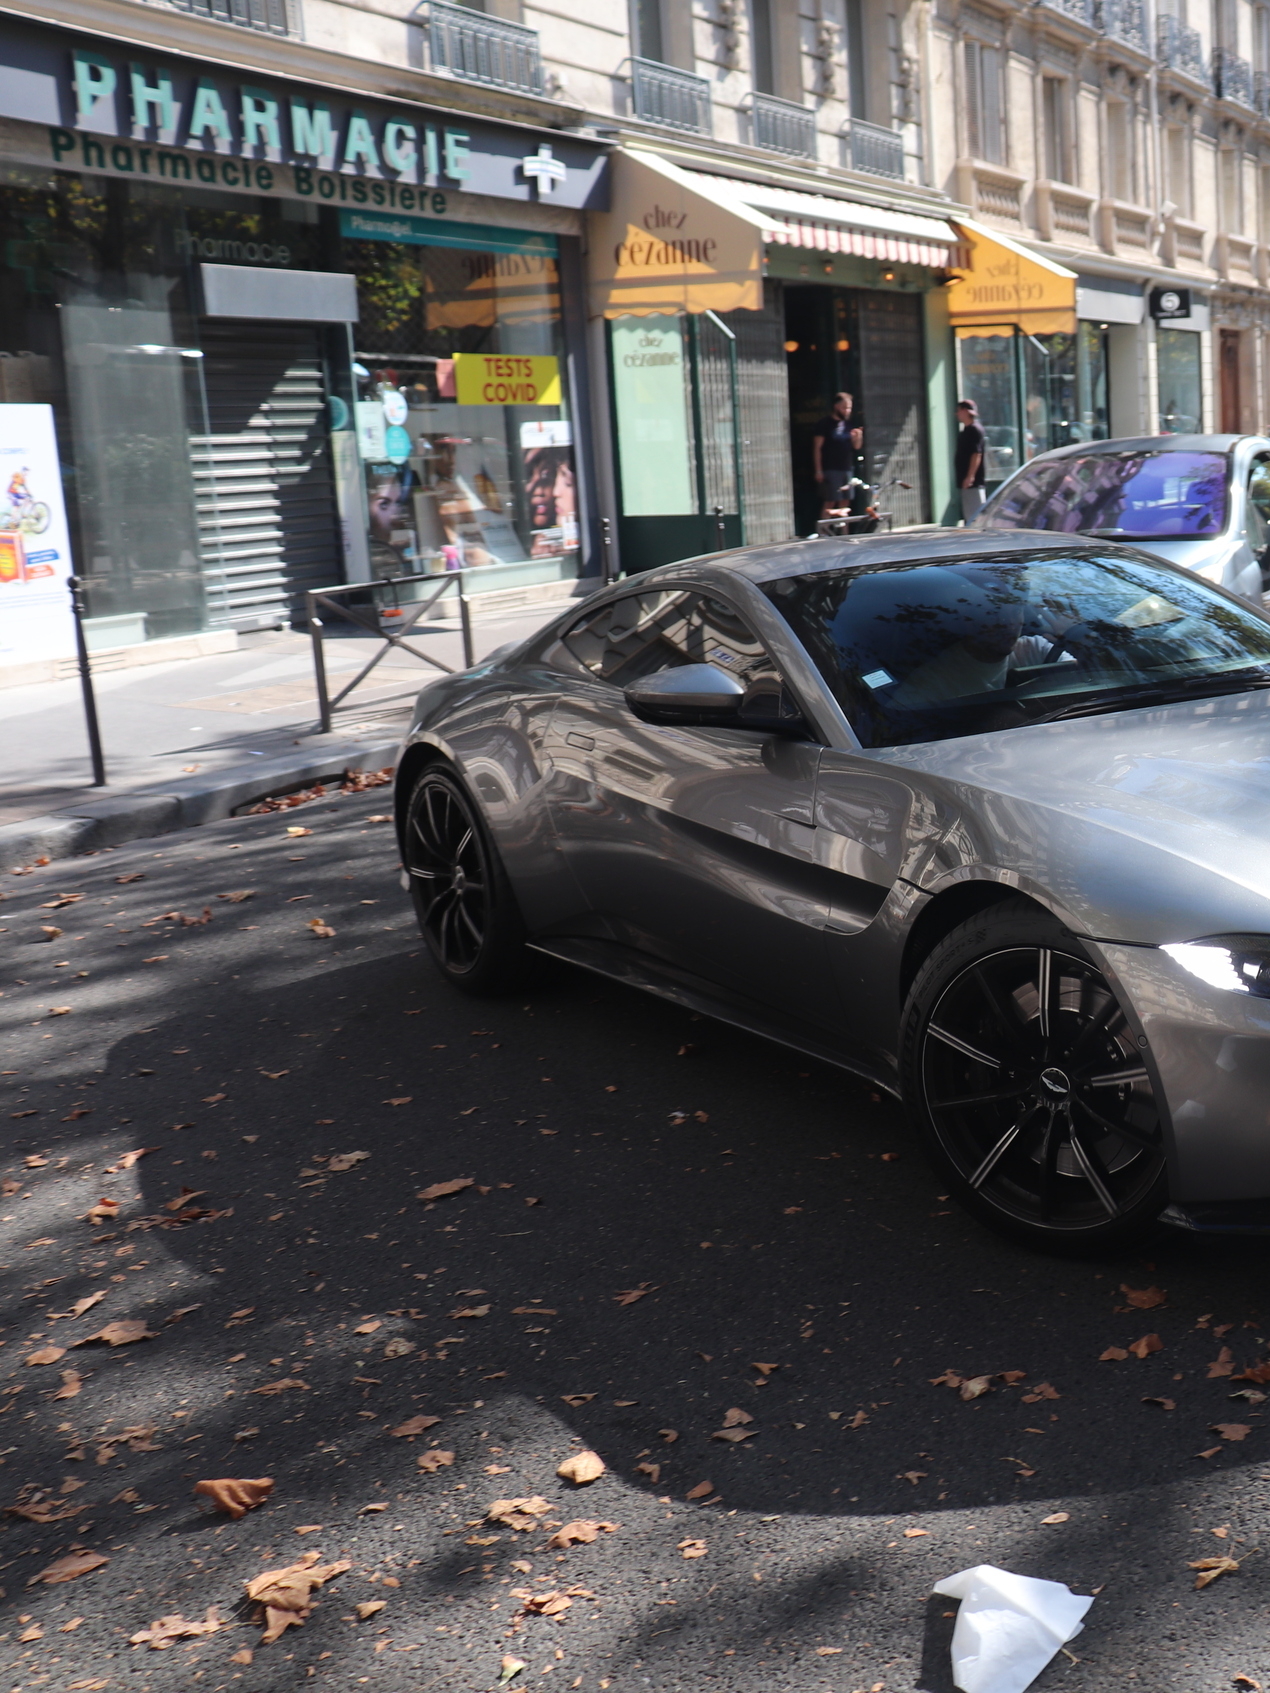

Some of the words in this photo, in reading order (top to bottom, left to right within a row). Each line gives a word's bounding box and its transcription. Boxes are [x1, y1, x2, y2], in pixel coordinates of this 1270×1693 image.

[73, 48, 472, 180] PHARMACIE
[50, 127, 274, 190] Pharmacie
[643, 204, 687, 230] chez
[175, 229, 291, 263] Pharmacie
[615, 231, 717, 266] cézanne
[639, 333, 663, 347] chez
[484, 357, 533, 377] TESTS
[483, 383, 538, 402] COVID
